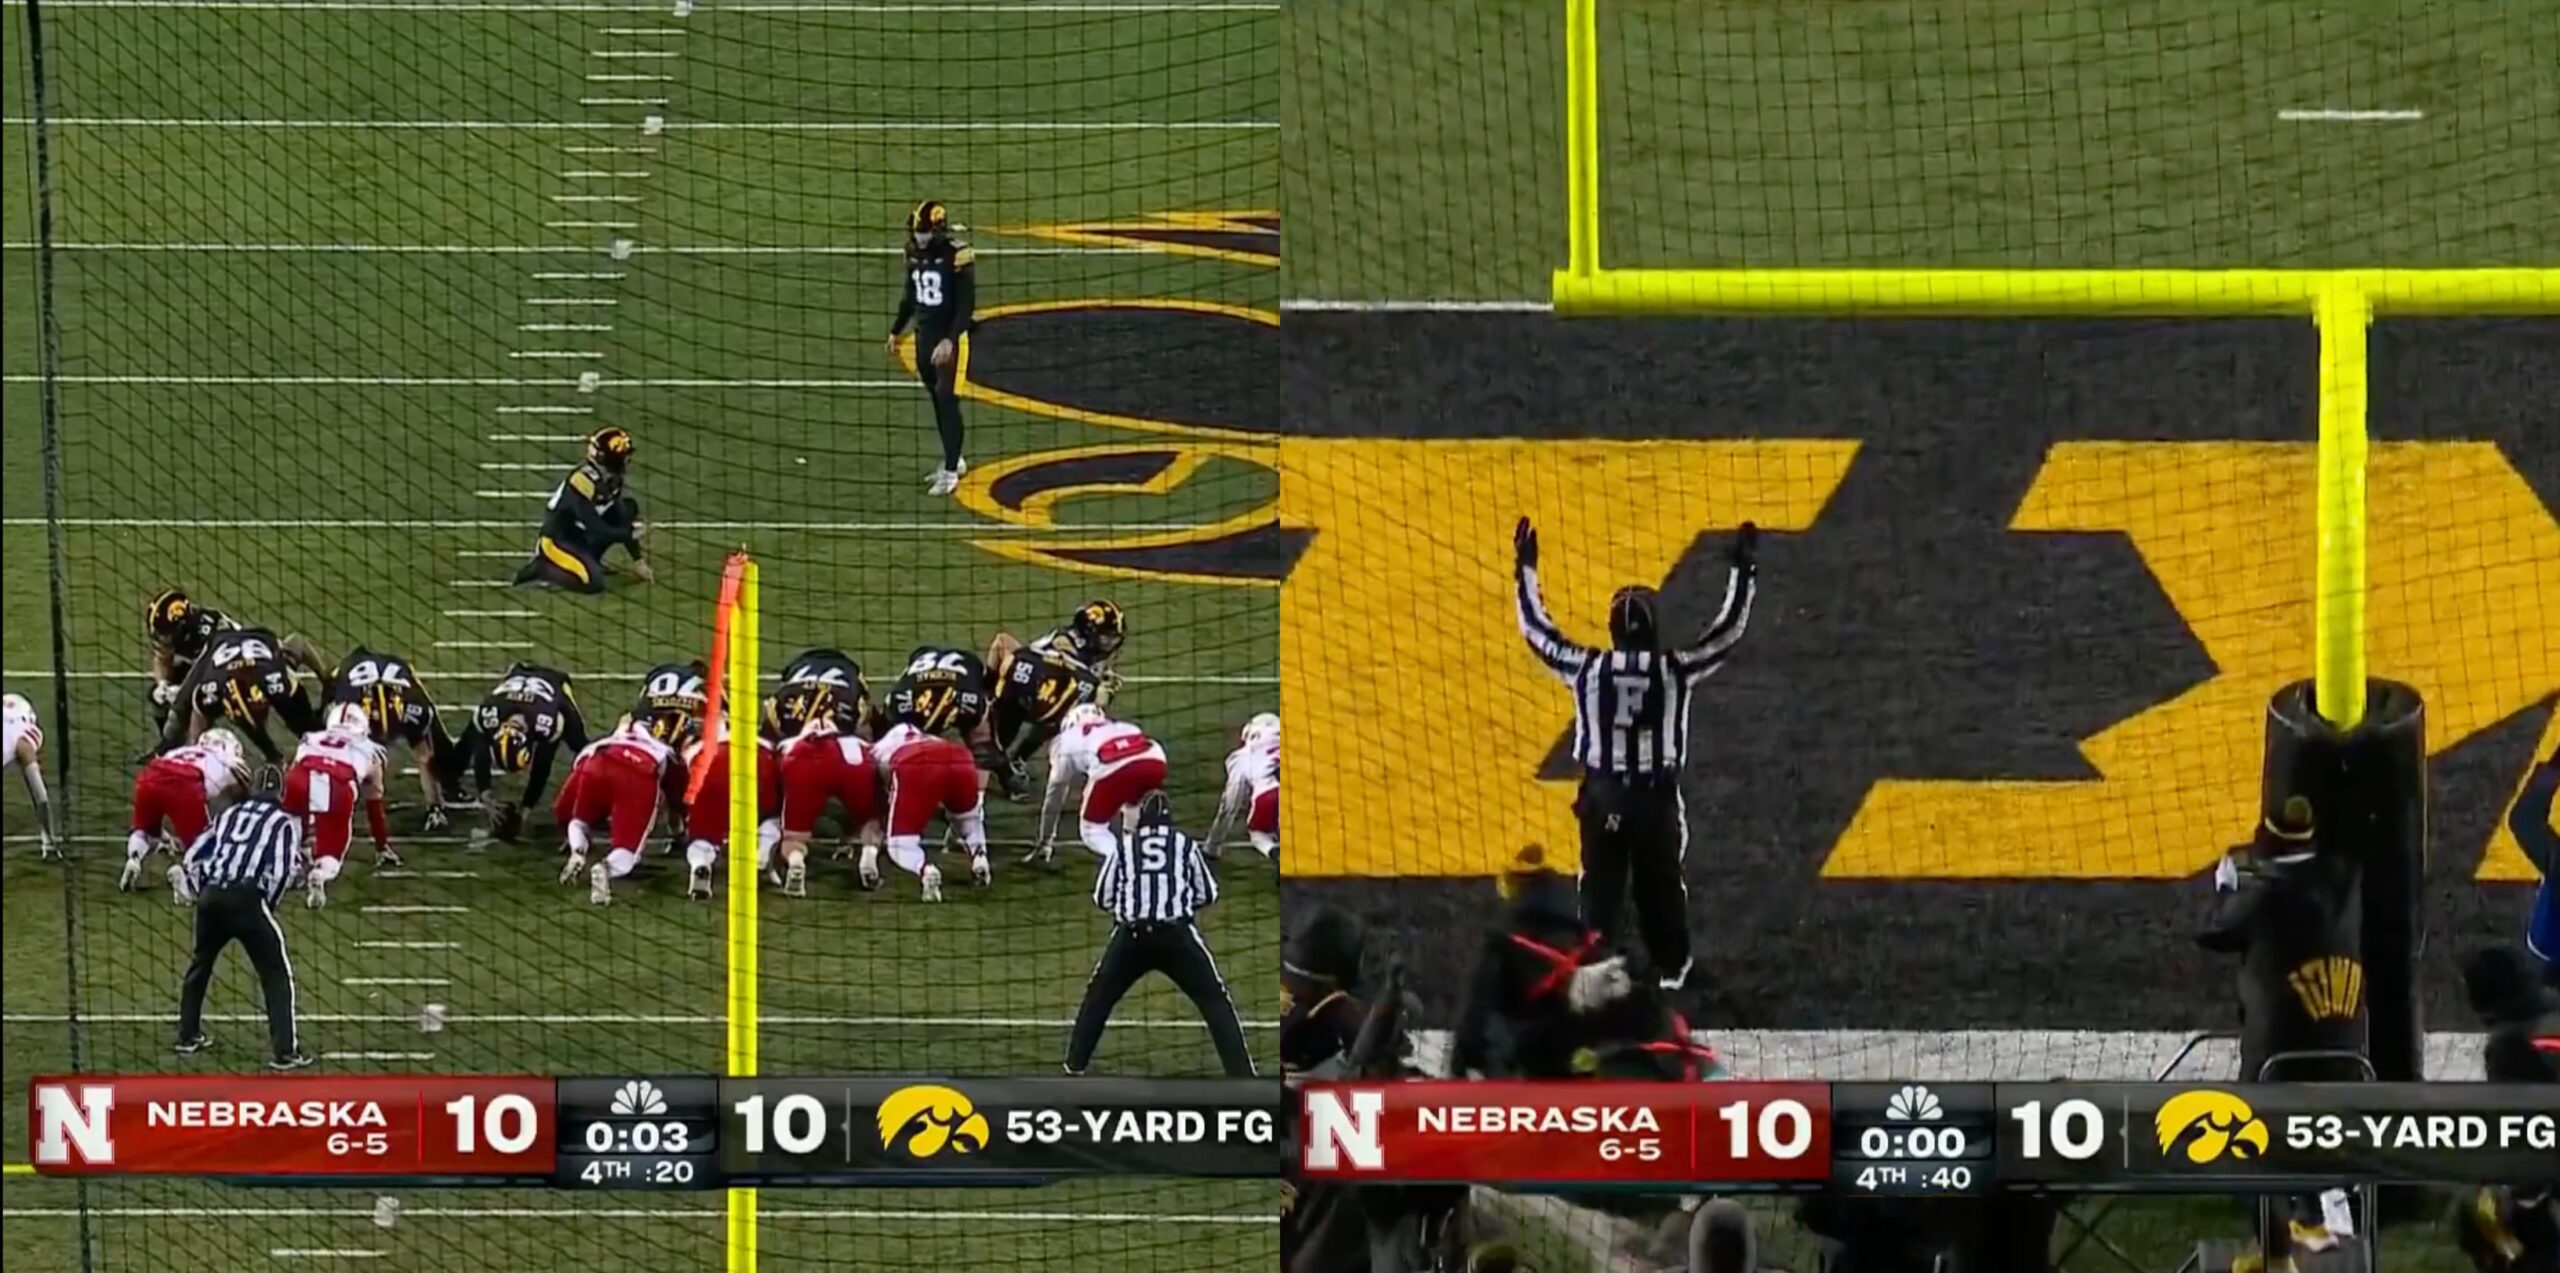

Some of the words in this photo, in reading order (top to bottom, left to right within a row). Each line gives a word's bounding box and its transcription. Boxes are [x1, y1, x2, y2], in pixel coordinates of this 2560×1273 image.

[911, 269, 943, 306] 18
[348, 660, 411, 688] 76
[646, 672, 708, 703] 70
[1613, 675, 1650, 727] F
[1141, 836, 1167, 870] S
